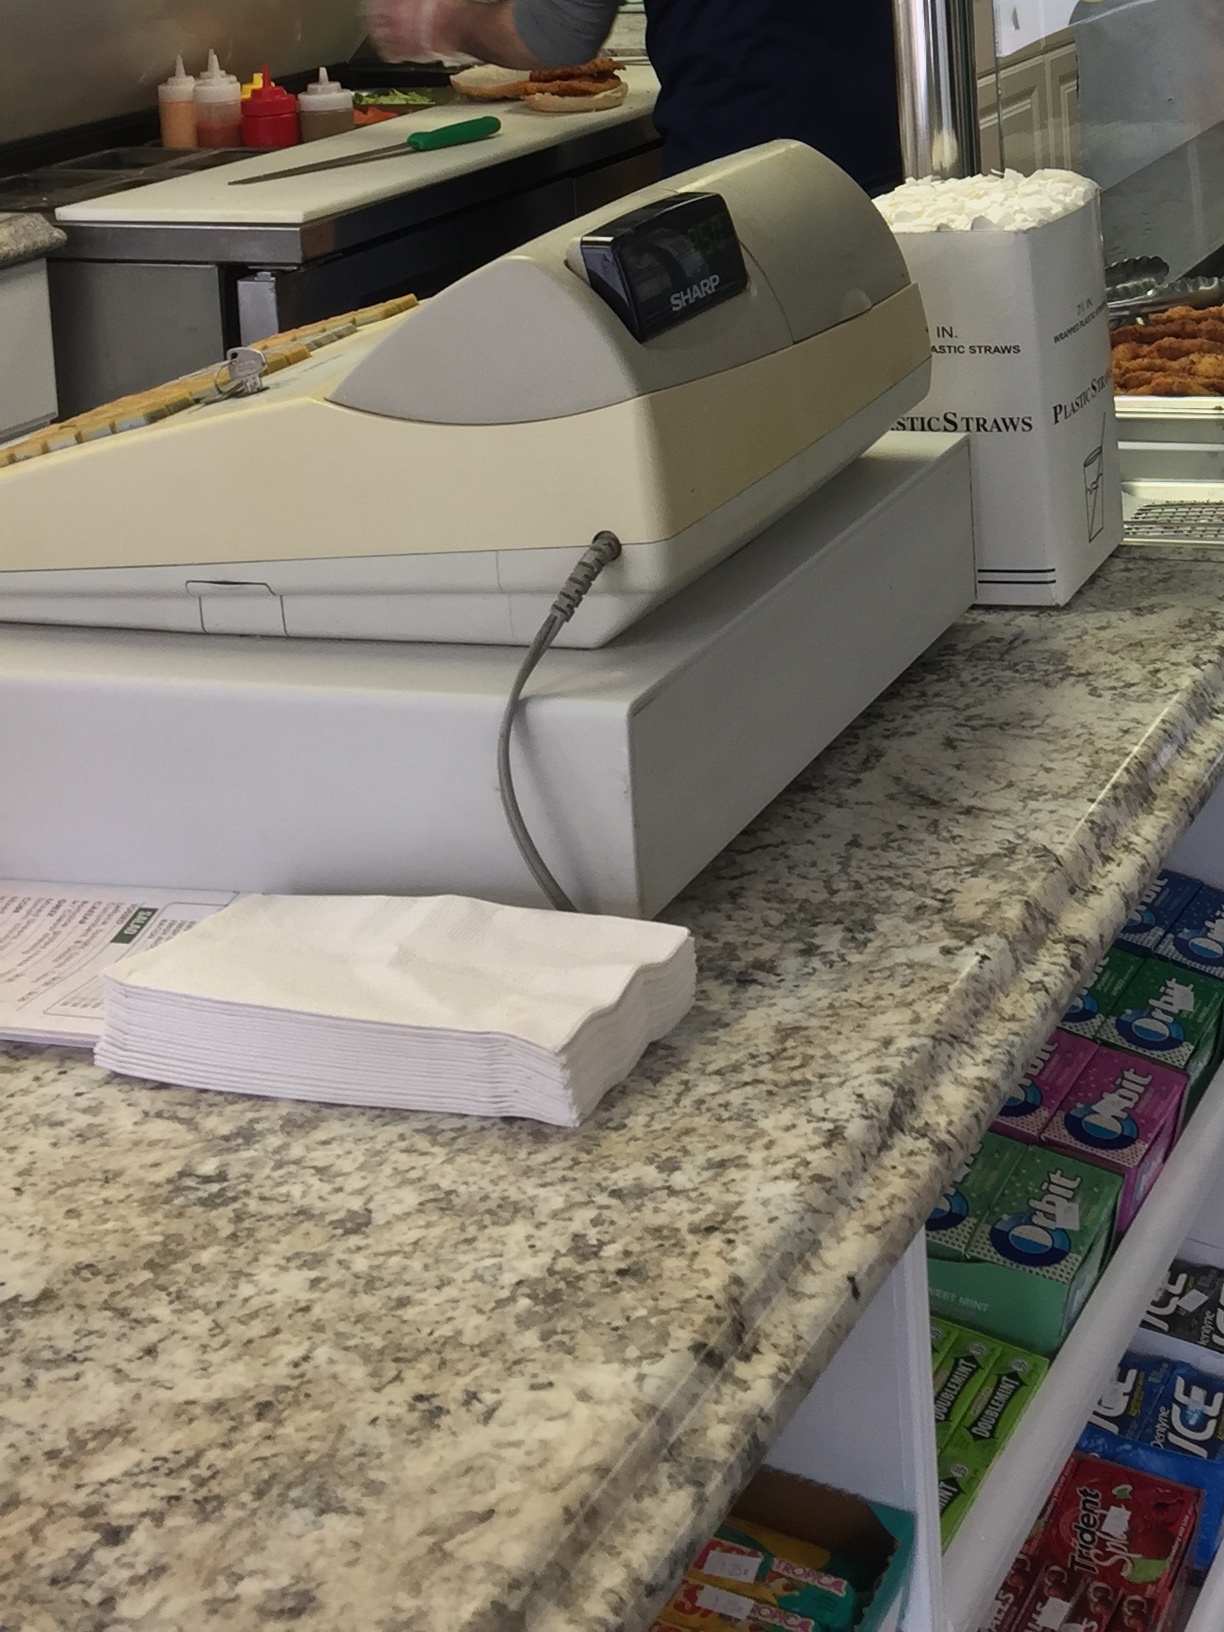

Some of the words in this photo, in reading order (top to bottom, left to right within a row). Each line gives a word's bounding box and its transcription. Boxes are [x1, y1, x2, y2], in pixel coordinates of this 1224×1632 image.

[669, 274, 720, 312] SHARP
[936, 326, 958, 339] IN.
[969, 345, 1021, 355] STRAWS
[1052, 387, 1091, 426] PLASTIC
[123, 909, 153, 936] SALAD
[959, 1295, 989, 1313] MINT
[935, 1358, 976, 1422] DOUBLEMINT
[971, 1375, 1021, 1439] DOUBLEMINT
[1168, 1375, 1224, 1459] ICE
[1067, 1486, 1102, 1576] Trident
